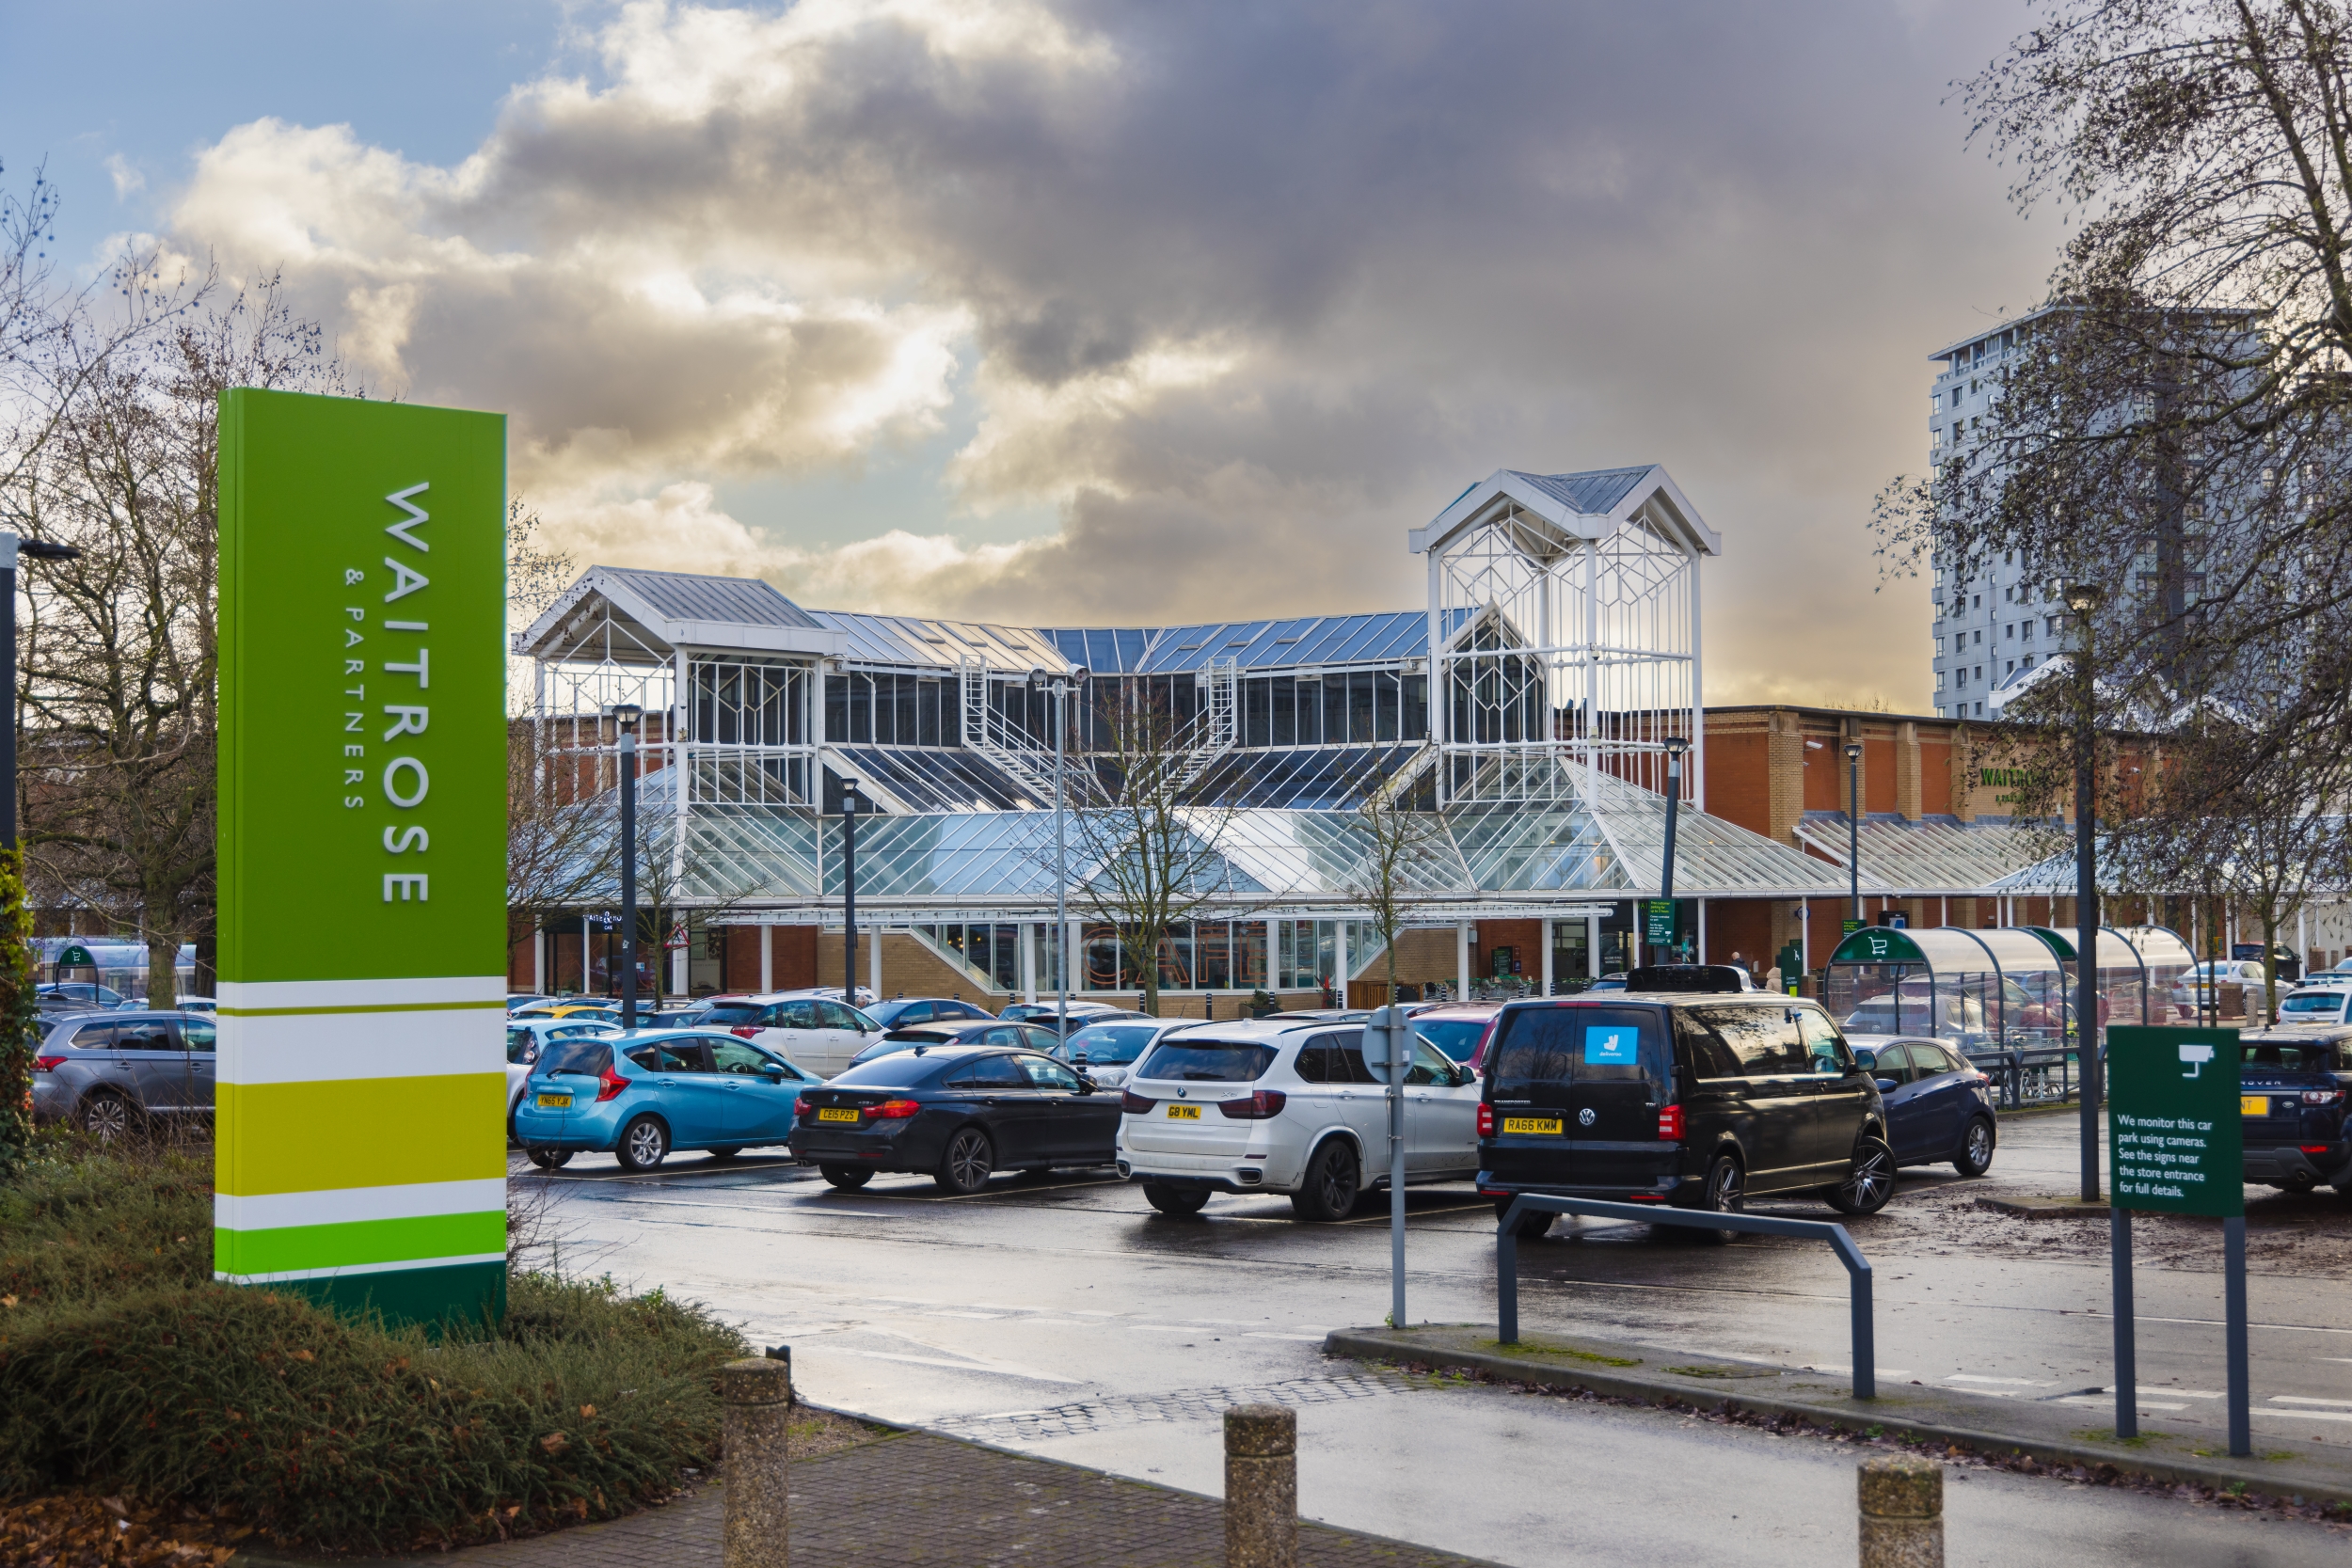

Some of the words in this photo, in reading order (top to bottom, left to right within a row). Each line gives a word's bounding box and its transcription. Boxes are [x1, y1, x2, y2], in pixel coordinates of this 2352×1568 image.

[344, 567, 365, 586] &
[384, 482, 429, 902] WAITROSE
[344, 607, 365, 809] PARTNERS
[1081, 921, 1268, 985] CAFÉ
[823, 1110, 838, 1119] CE15
[839, 1110, 854, 1119] PZS
[1168, 1106, 1180, 1117] G8
[1182, 1107, 1199, 1118] YML
[1508, 1119, 1534, 1131] RA66
[1537, 1119, 1557, 1132] KMM
[2118, 1114, 2135, 1126] We
[2137, 1117, 2175, 1129] monitor
[2177, 1117, 2195, 1130] this
[2197, 1121, 2212, 1131] car
[2118, 1132, 2137, 1145] park
[2140, 1133, 2164, 1148] using
[2166, 1136, 2207, 1148] cameras.
[2119, 1148, 2135, 1160] See
[2137, 1149, 2153, 1161] the
[2153, 1151, 2176, 1164] signs
[2179, 1154, 2200, 1164] near
[2119, 1165, 2135, 1176] the
[2137, 1167, 2162, 1179] store
[2164, 1169, 2205, 1181] entrance
[2119, 1181, 2133, 1193] for
[2135, 1182, 2150, 1195] full
[2152, 1184, 2184, 1197] details.
